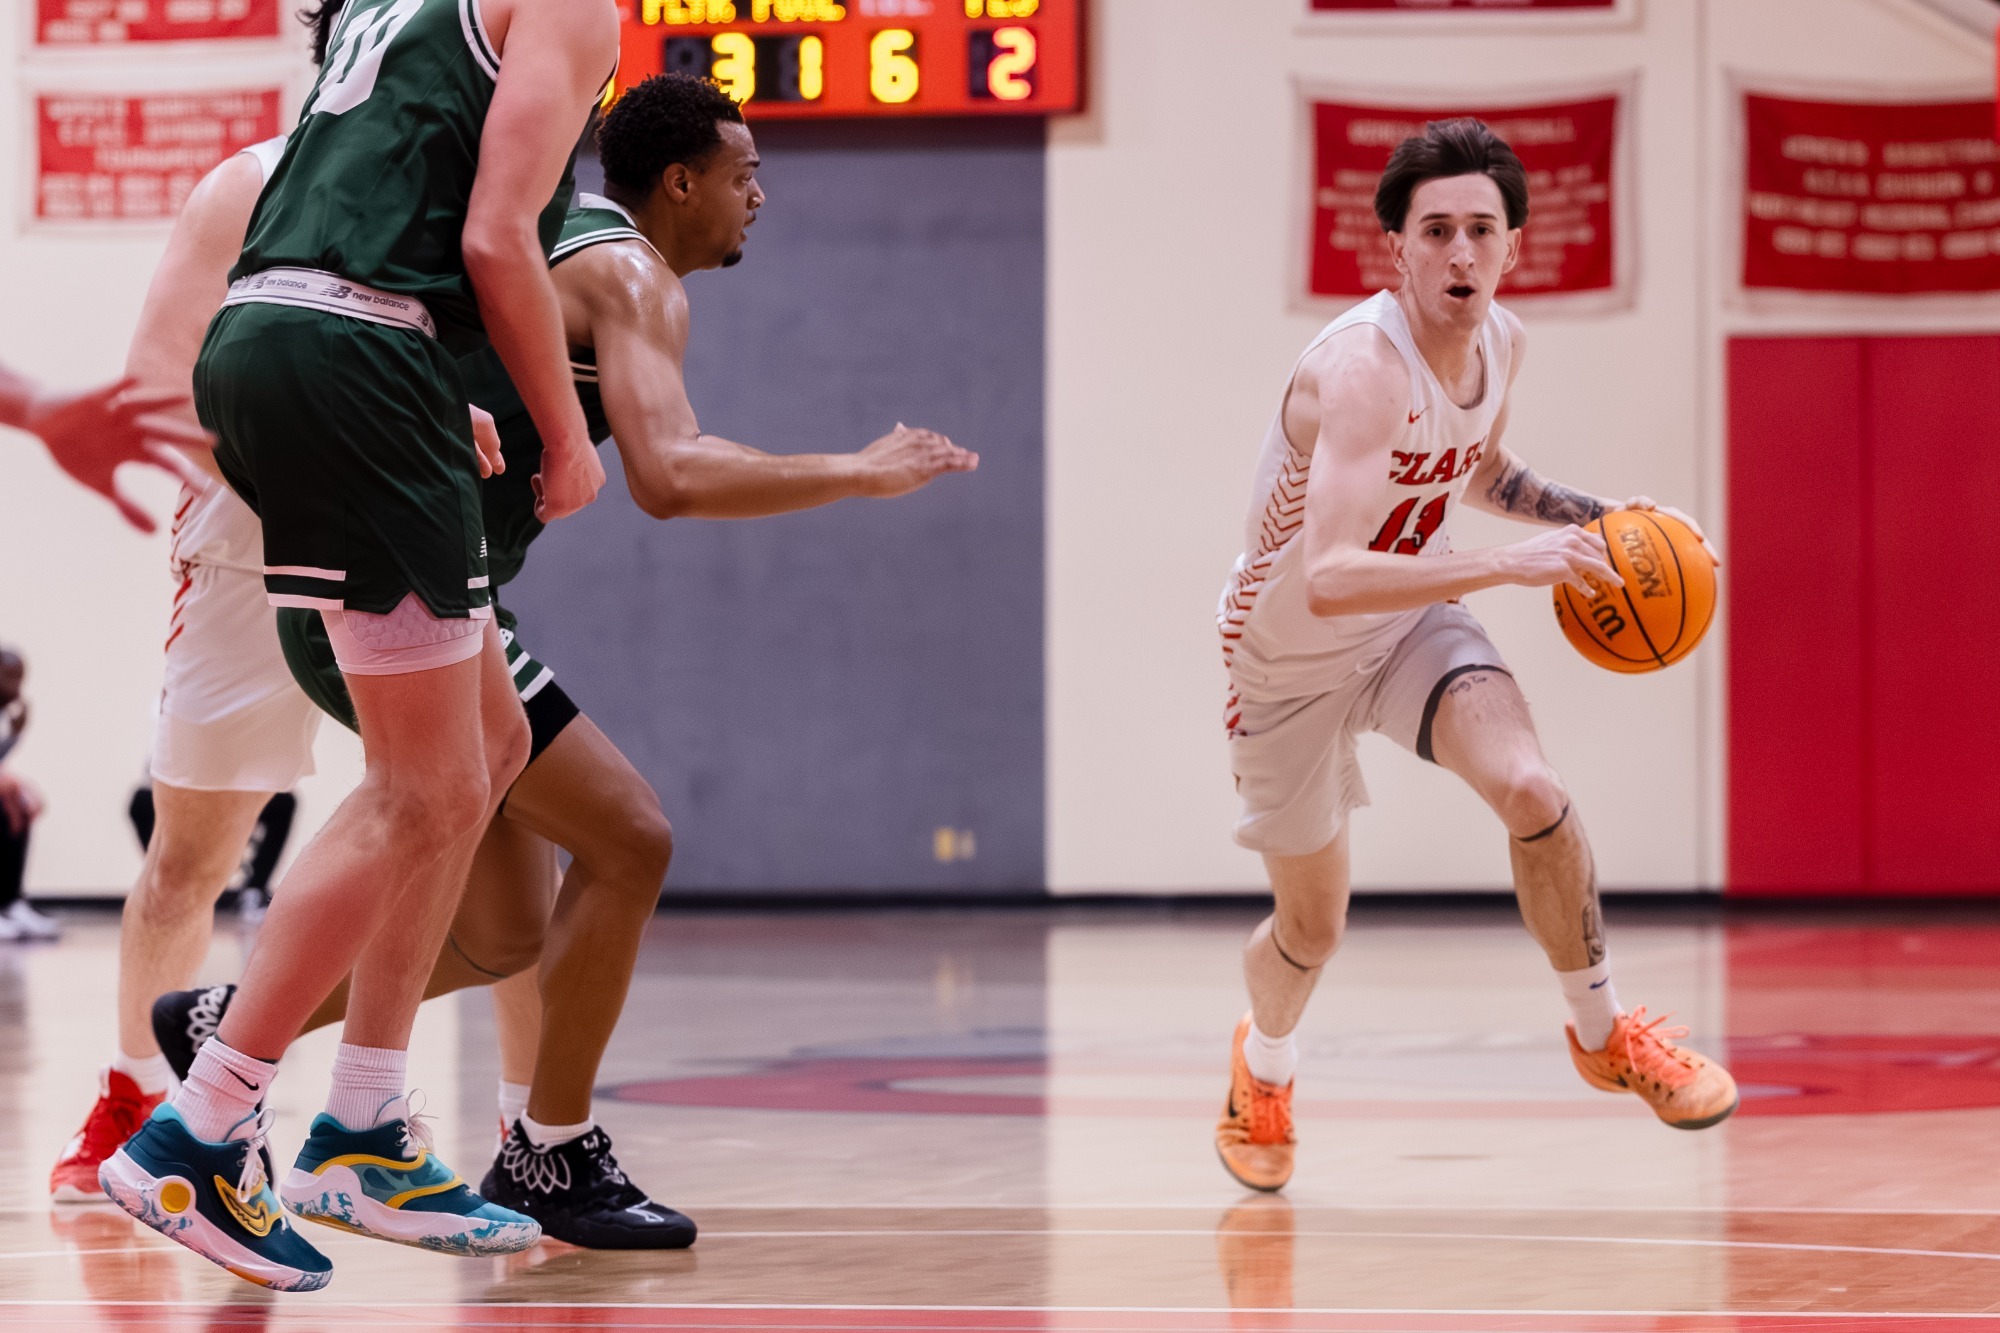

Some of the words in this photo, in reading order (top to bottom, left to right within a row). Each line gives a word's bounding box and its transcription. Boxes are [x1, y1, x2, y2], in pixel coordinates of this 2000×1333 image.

[870, 28, 919, 103] 6
[987, 26, 1036, 100] 2
[352, 292, 373, 303] new
[373, 295, 410, 311] balance
[1388, 435, 1488, 486] CLAR
